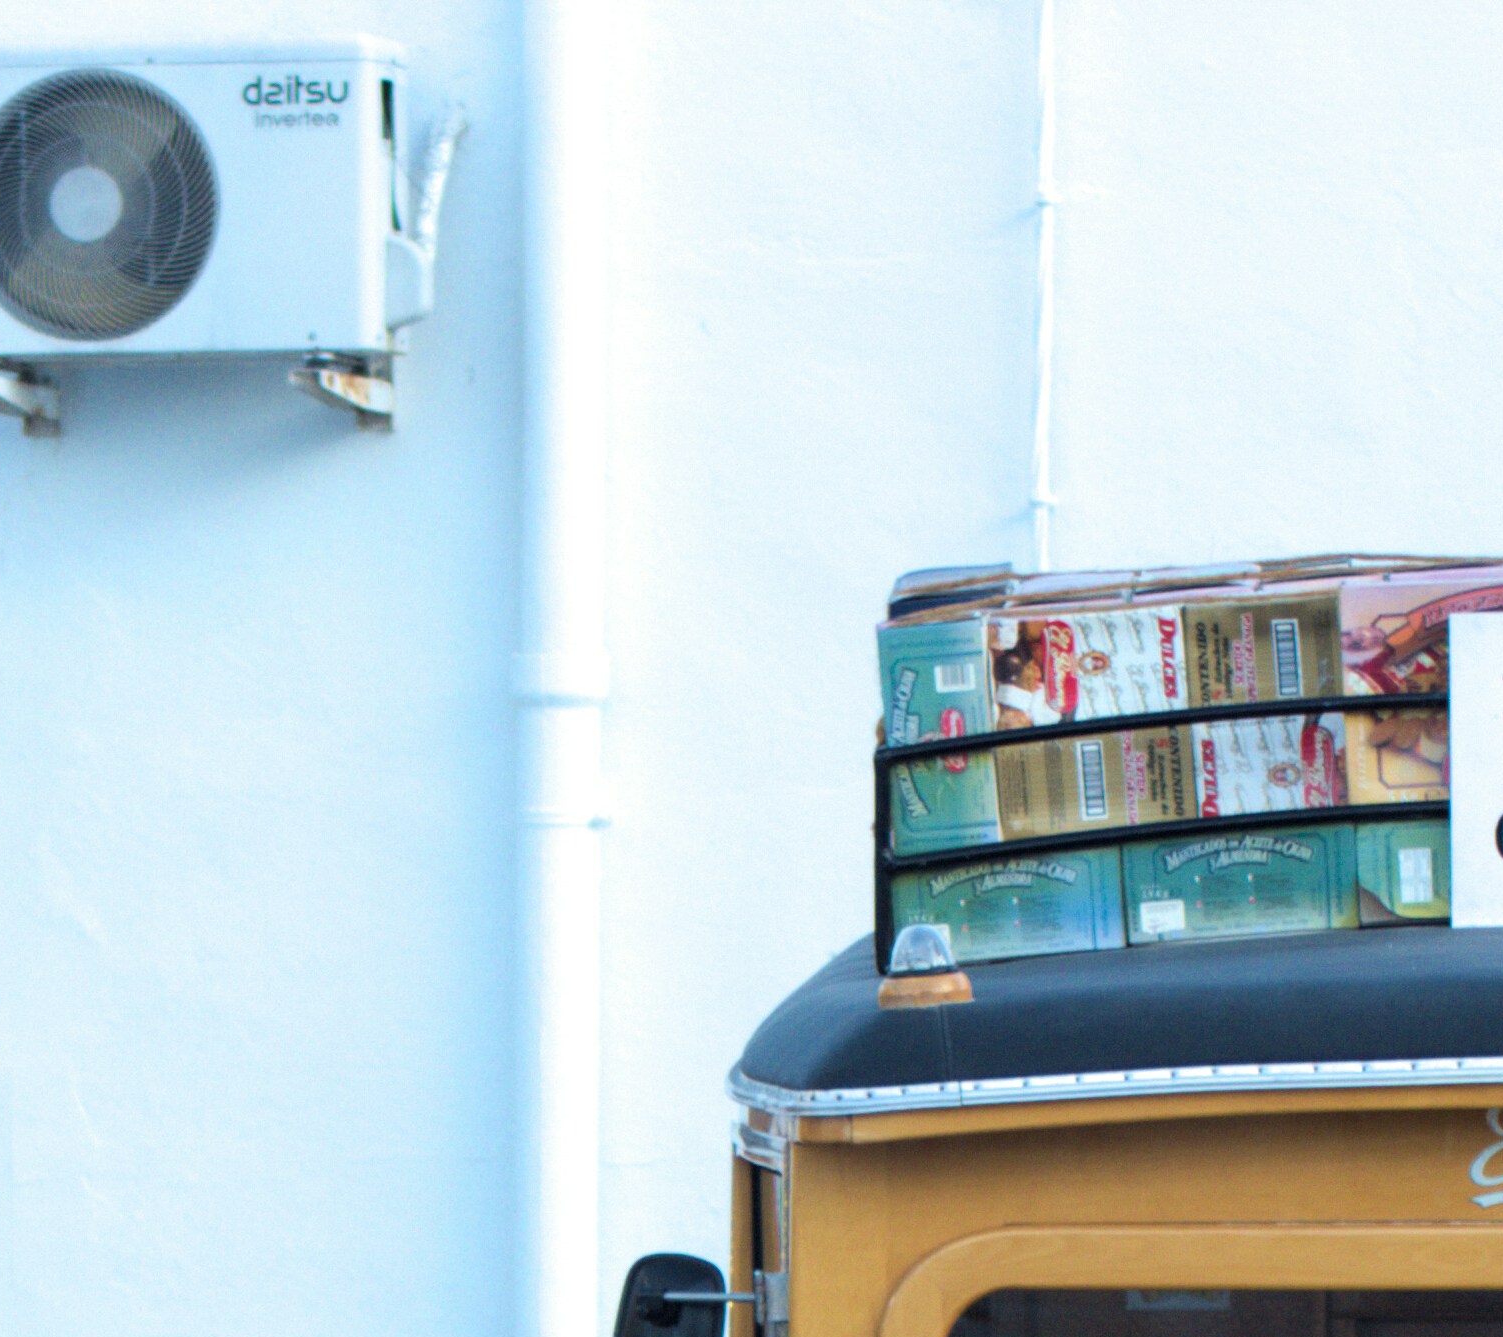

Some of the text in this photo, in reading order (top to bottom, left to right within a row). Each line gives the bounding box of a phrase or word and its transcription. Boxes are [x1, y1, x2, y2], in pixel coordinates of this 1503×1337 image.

[1157, 616, 1178, 699] DULCES
[1196, 621, 1211, 702] ONTENIDO
[1201, 740, 1219, 818] DULCES
